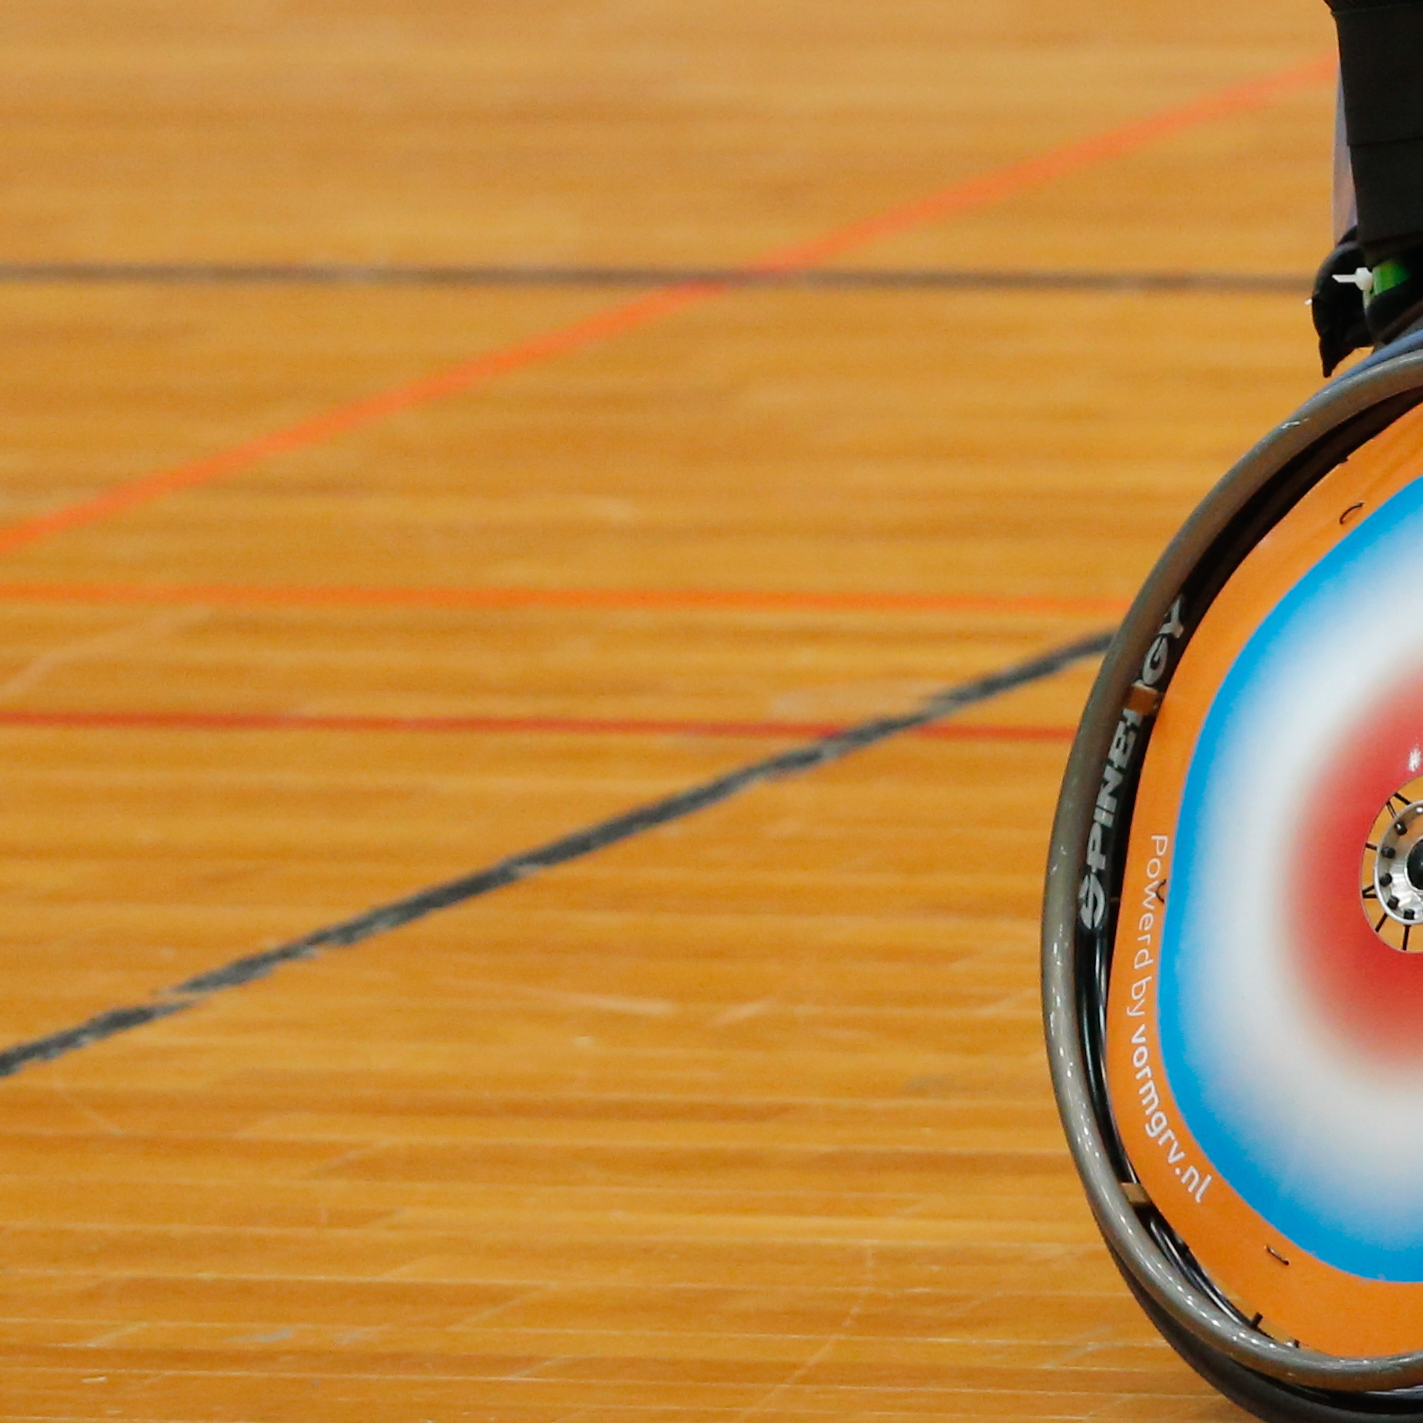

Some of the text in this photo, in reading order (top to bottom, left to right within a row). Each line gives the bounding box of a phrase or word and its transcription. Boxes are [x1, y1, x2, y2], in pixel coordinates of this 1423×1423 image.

[1126, 834, 1213, 1204] Powerd by vormgrv.nl
